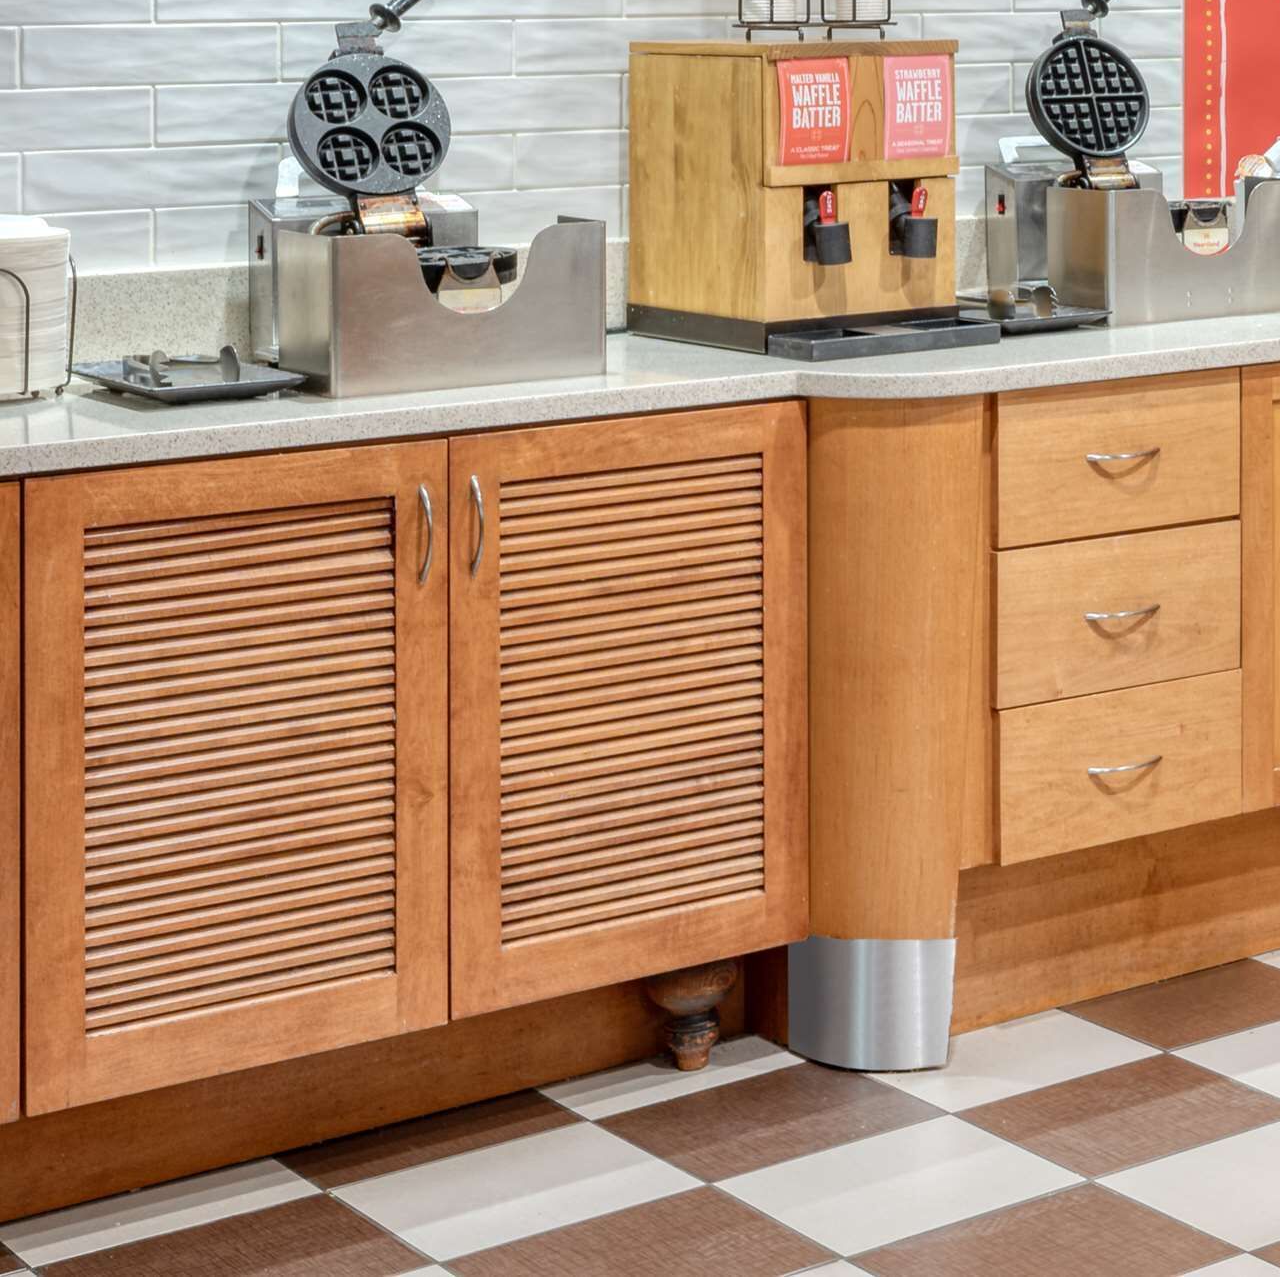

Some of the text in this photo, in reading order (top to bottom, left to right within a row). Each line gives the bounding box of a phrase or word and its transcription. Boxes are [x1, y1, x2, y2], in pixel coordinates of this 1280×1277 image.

[895, 68, 941, 80] STRAWBERRY
[792, 83, 841, 106] WAFFLE
[896, 79, 942, 101] WAFFLE
[792, 106, 841, 129] BATTER
[896, 102, 942, 123] BATTER
